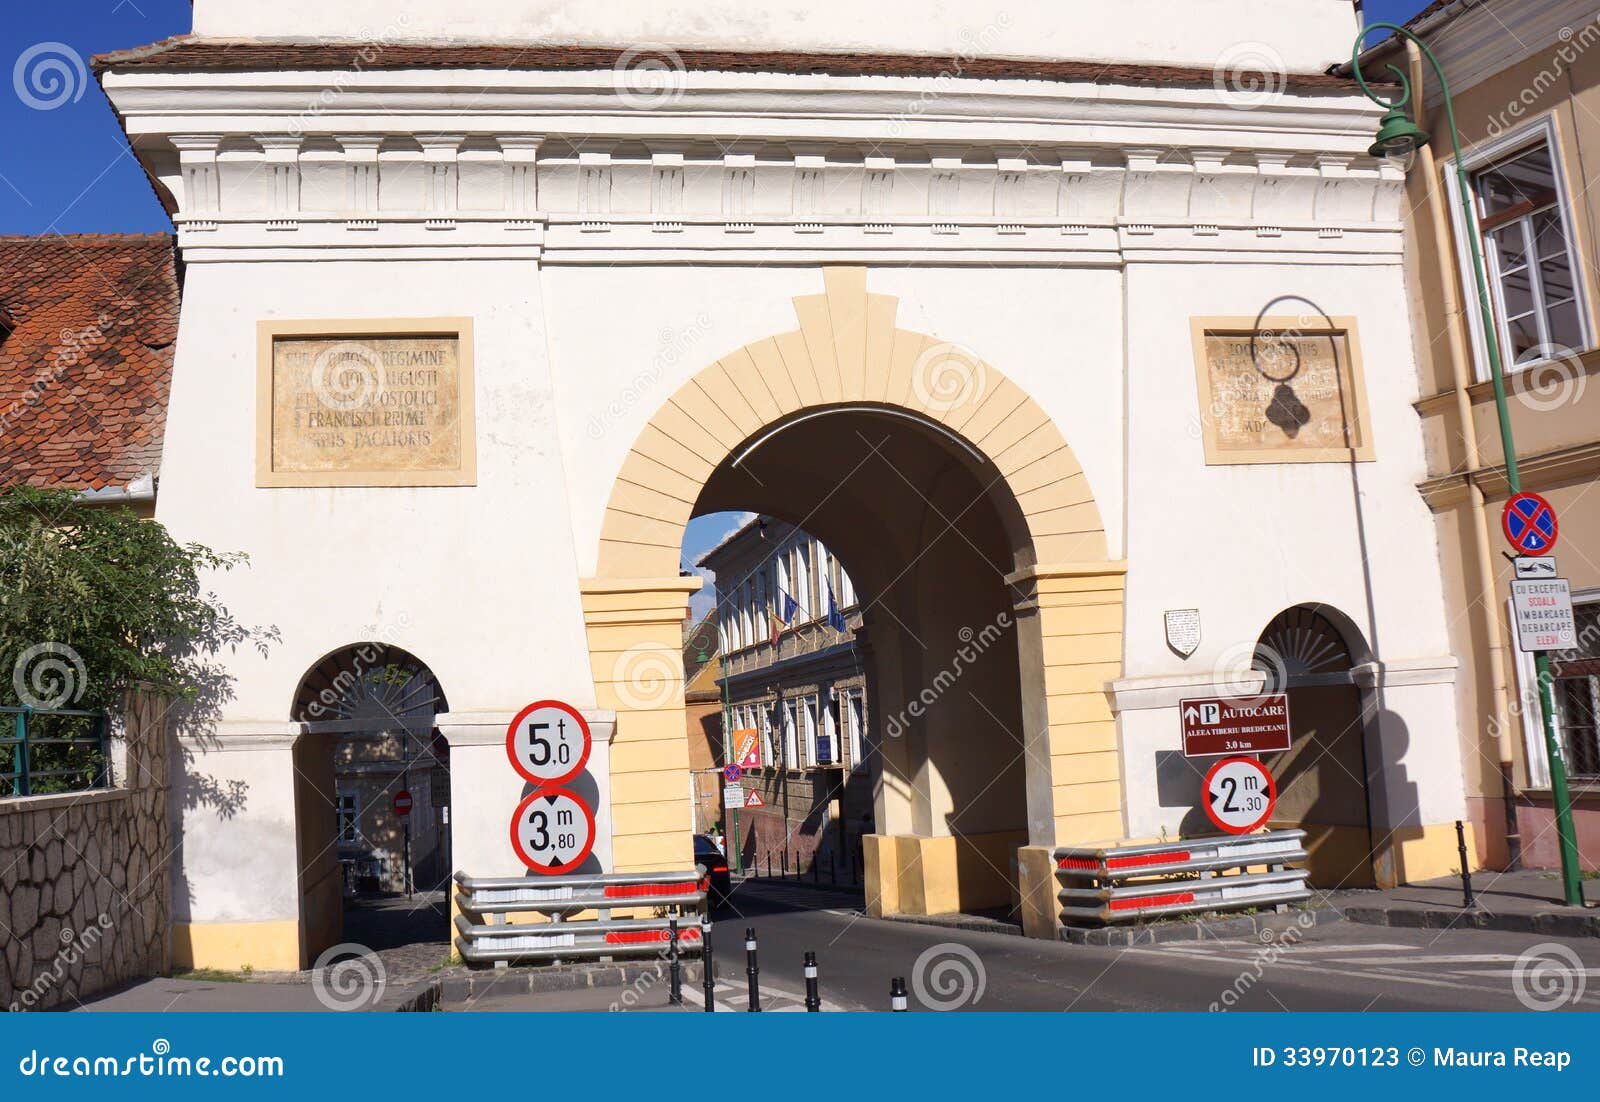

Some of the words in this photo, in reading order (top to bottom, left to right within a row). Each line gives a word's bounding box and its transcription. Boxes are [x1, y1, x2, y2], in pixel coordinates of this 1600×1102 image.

[1515, 585, 1526, 594] CU
[1204, 705, 1217, 723] P
[1221, 705, 1285, 719] AUTOCARE
[1187, 729, 1211, 737] ALEEA
[1212, 727, 1240, 736] TIBERIU
[1241, 724, 1287, 734] BREDICEANU
[1239, 740, 1252, 749] km
[1244, 775, 1258, 790] m
[557, 809, 573, 825] m
